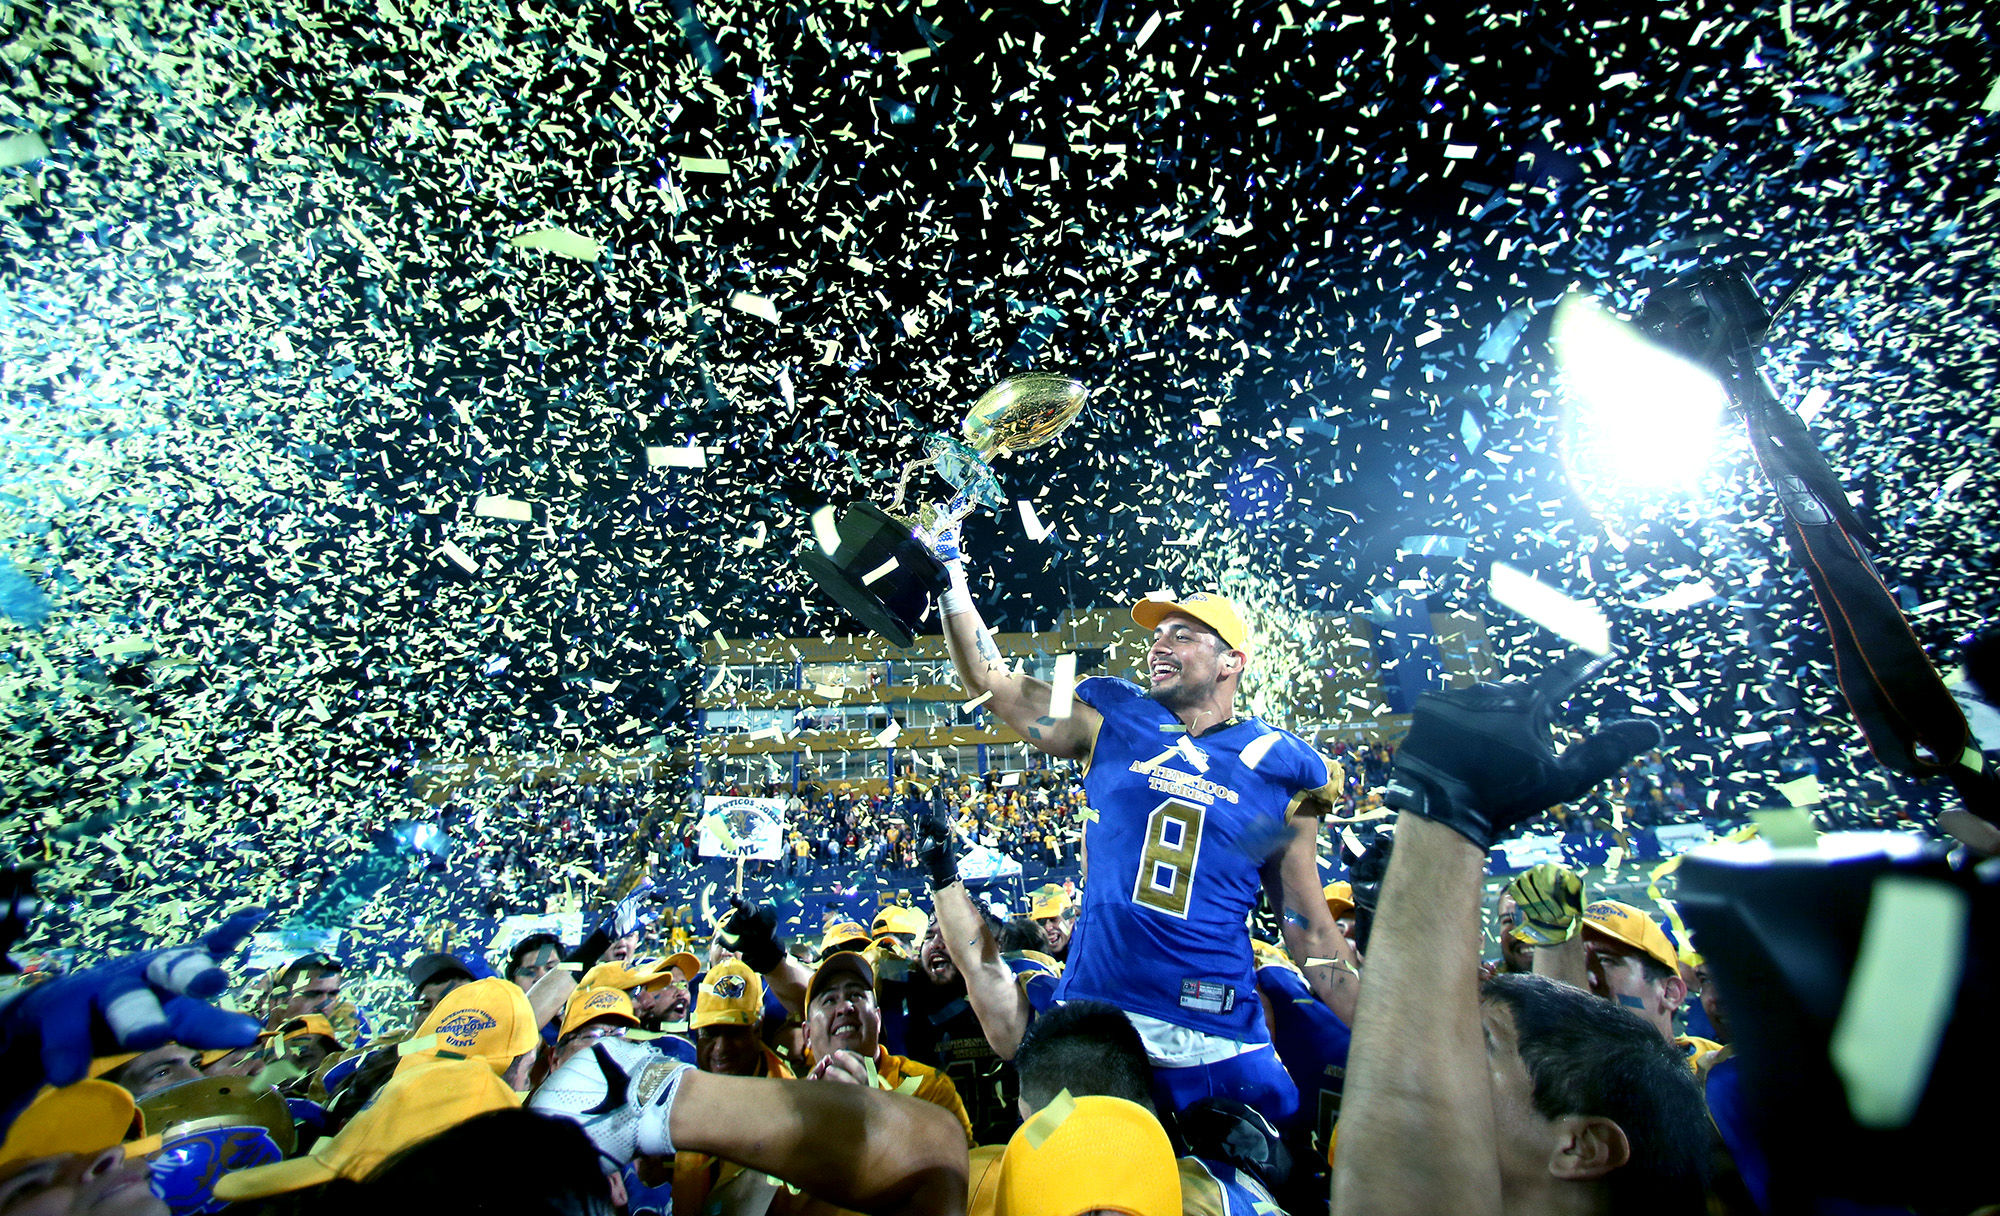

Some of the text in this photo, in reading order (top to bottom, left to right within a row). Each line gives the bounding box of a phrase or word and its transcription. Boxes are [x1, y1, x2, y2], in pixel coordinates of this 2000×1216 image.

[1128, 760, 1239, 804] ATENICOS
[1148, 776, 1215, 805] TIGRES
[1132, 797, 1206, 920] 8
